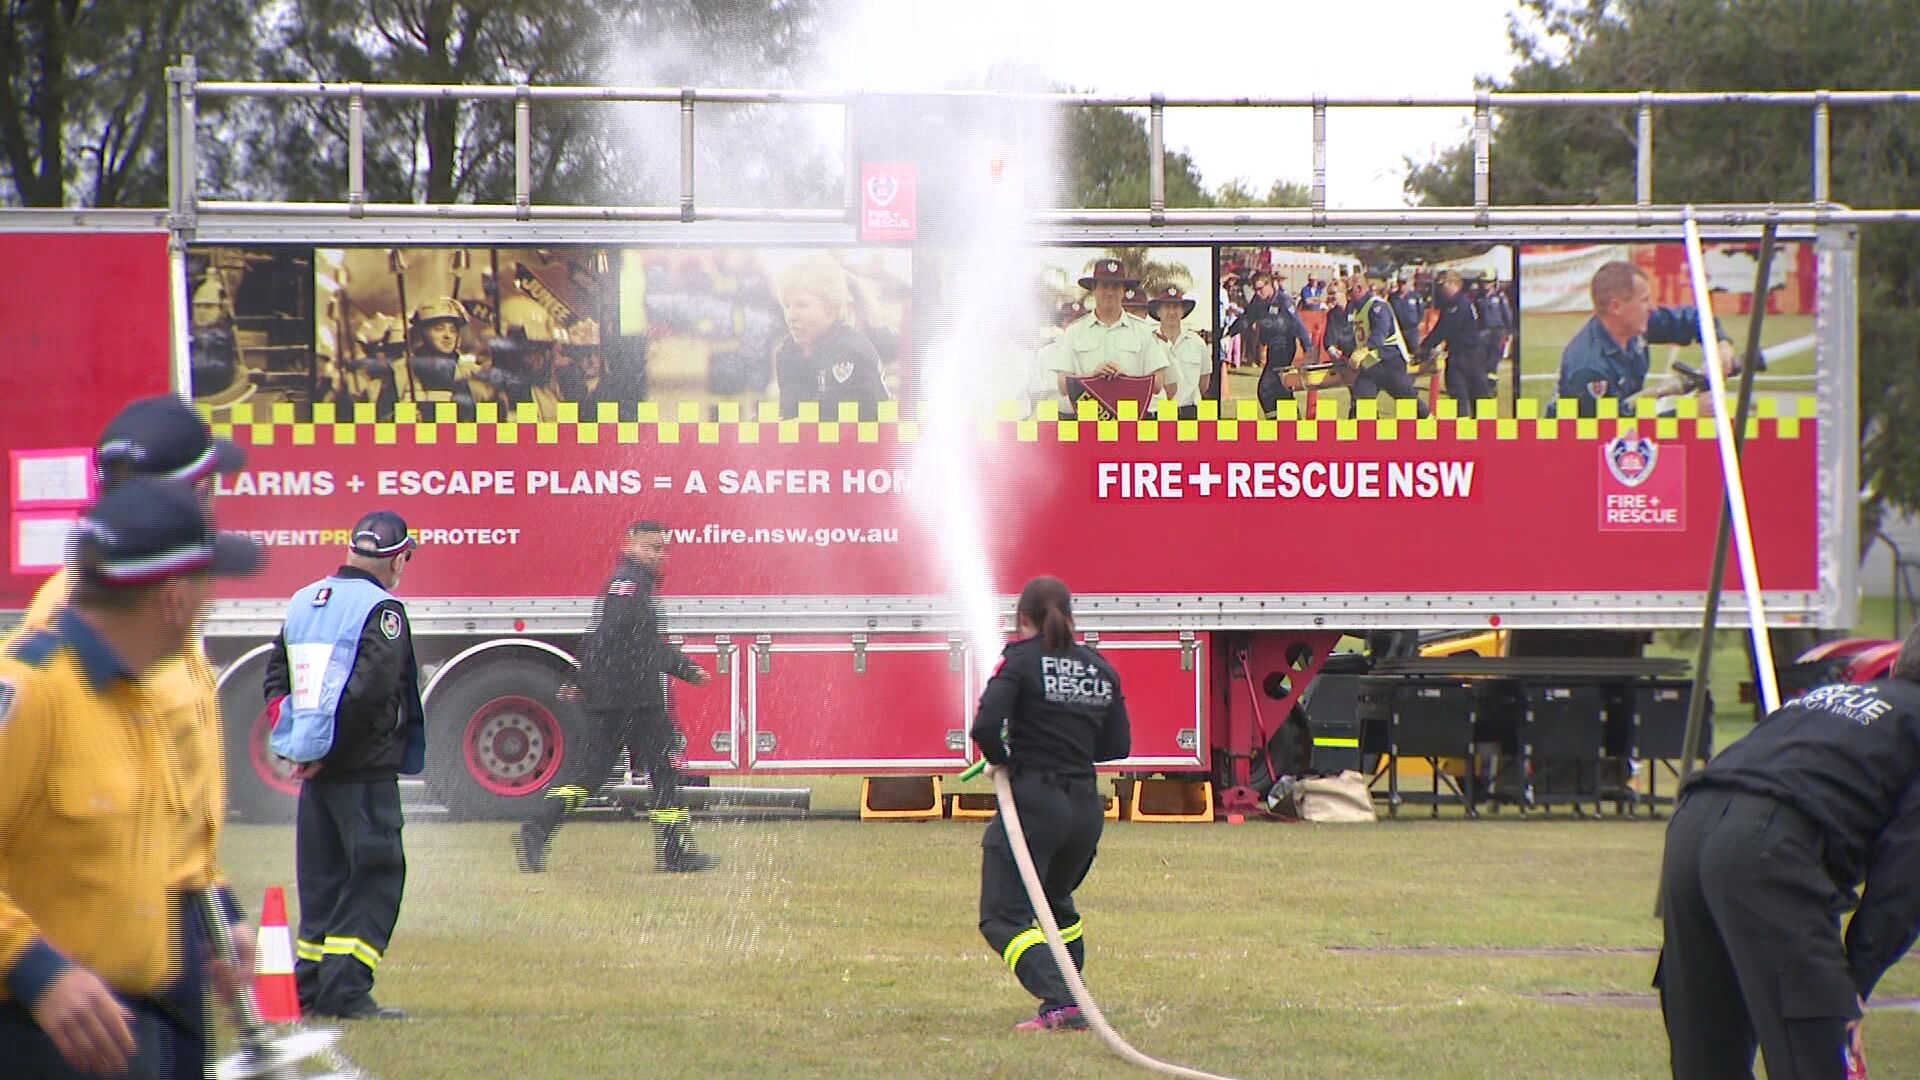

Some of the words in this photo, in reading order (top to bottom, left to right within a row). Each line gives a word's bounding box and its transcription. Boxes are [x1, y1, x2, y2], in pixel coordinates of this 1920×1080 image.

[215, 470, 335, 496] LARMS
[377, 470, 516, 495] ESCAPE
[526, 469, 642, 495] PLANS
[684, 469, 708, 494] A
[718, 469, 831, 495] SAFER
[842, 469, 912, 494] HOM
[1388, 461, 1475, 498] NSW
[1606, 508, 1678, 524] RESCUE
